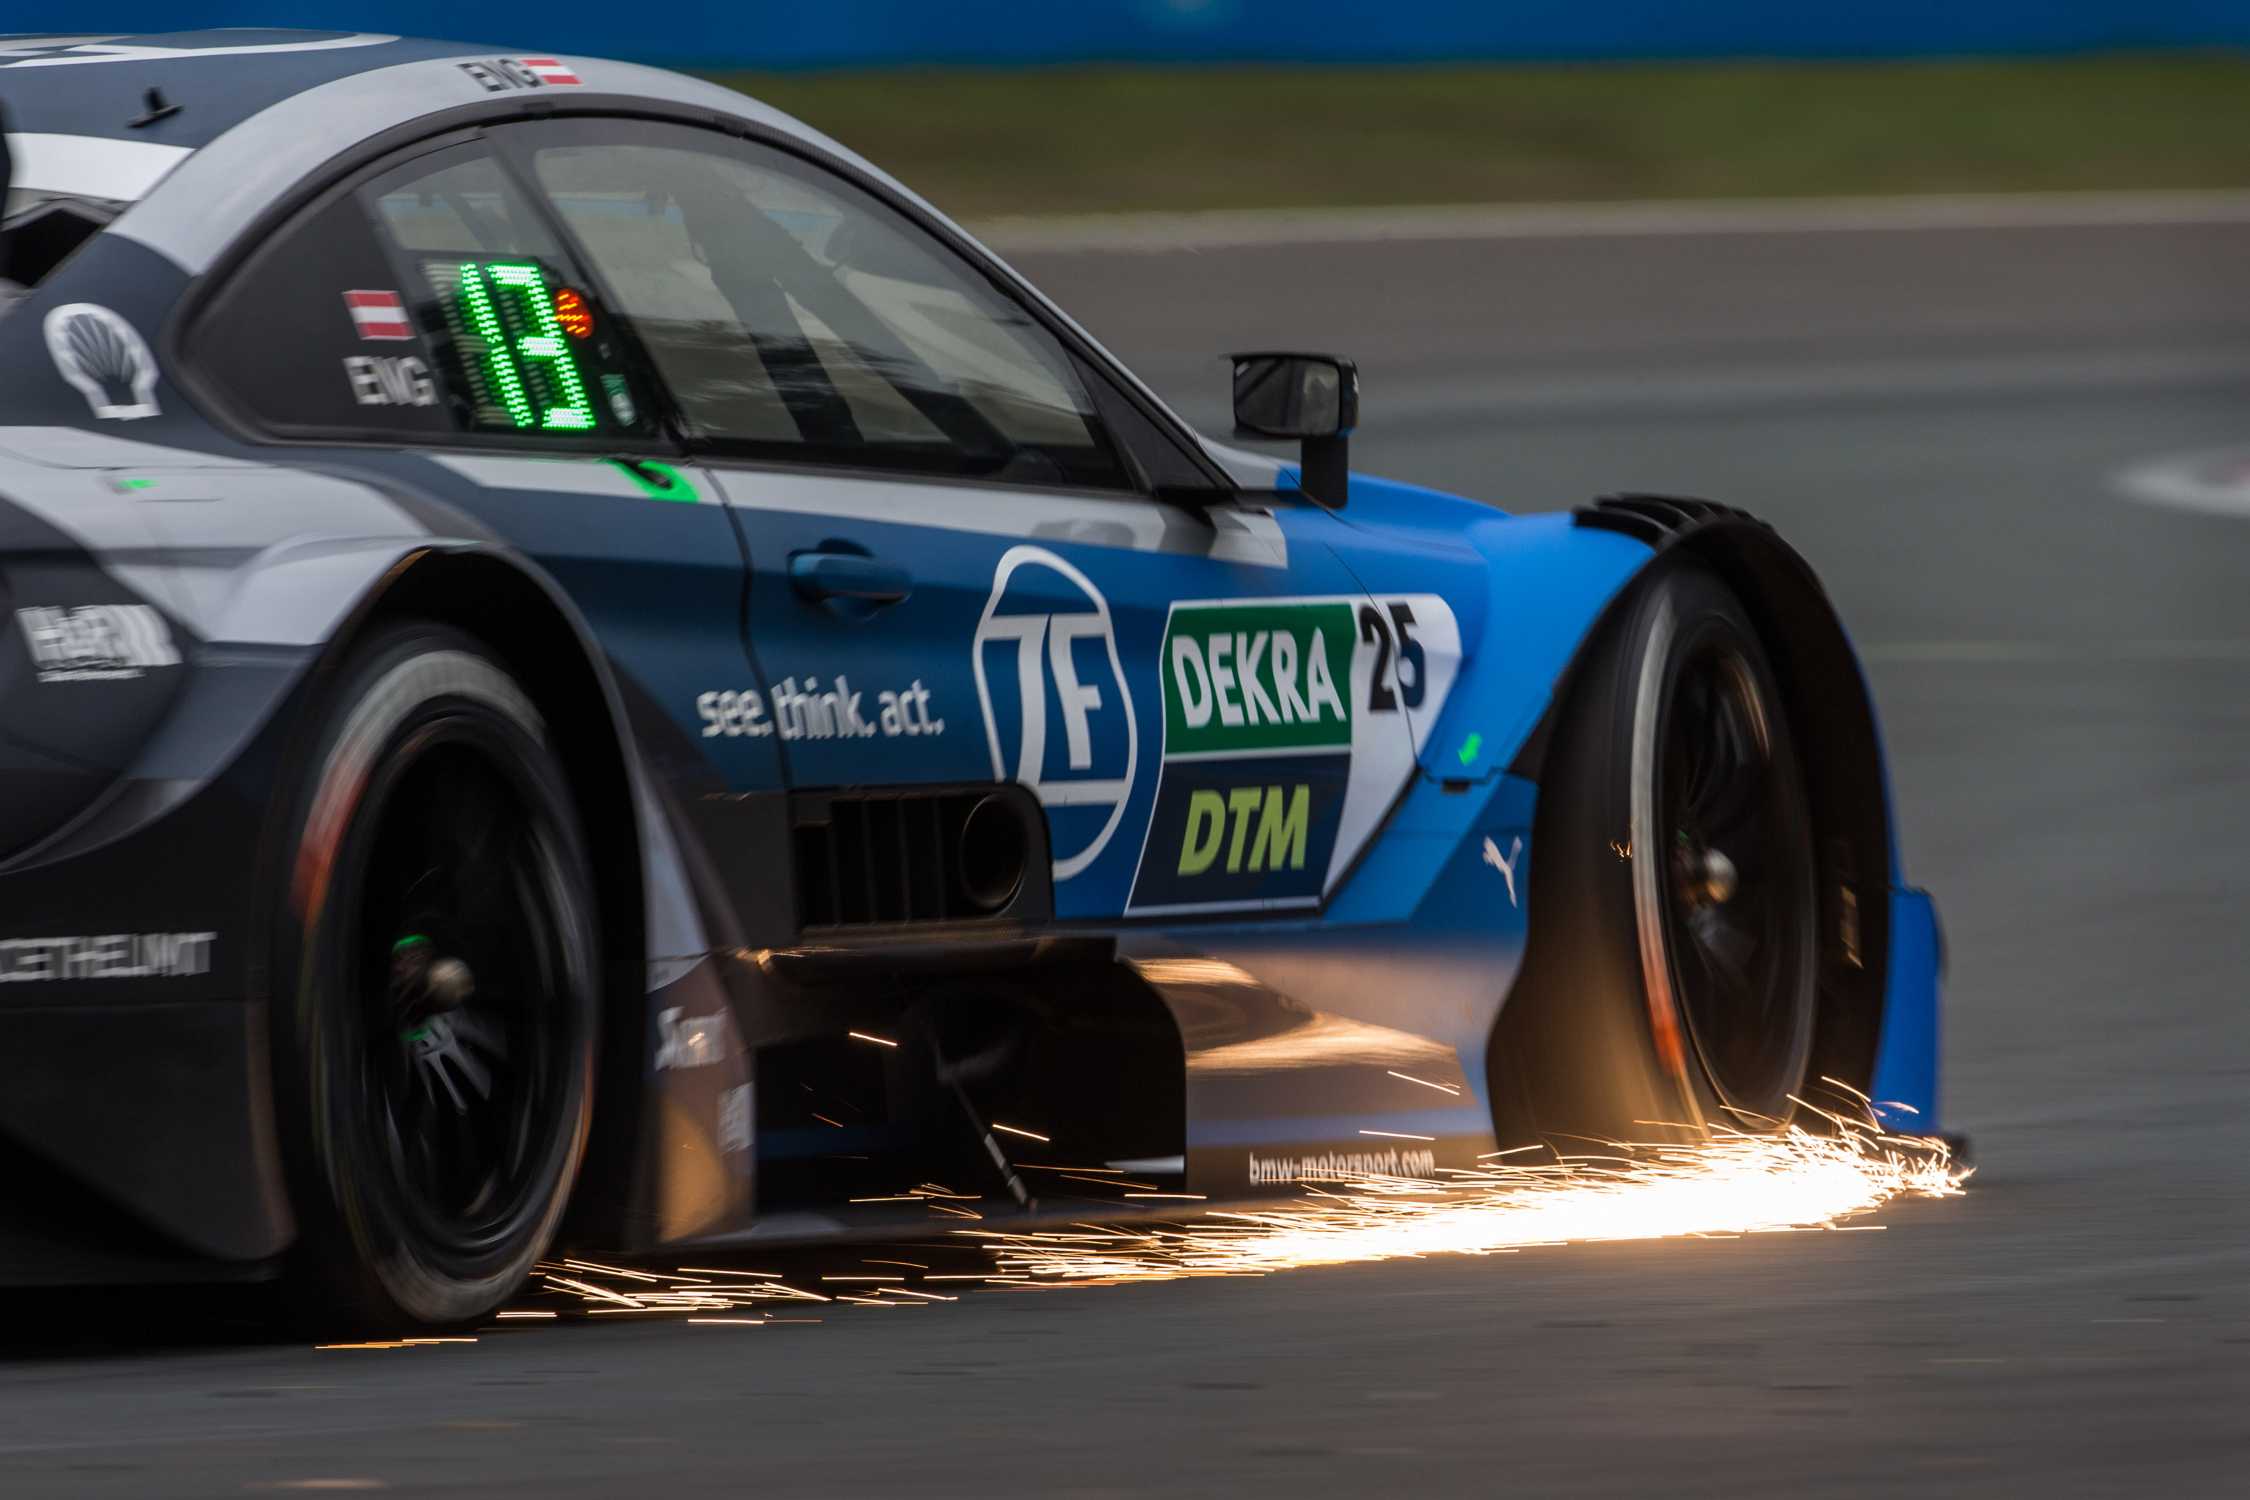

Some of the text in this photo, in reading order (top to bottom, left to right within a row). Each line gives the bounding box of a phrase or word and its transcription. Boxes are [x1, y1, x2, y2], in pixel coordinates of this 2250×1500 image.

[344, 355, 438, 406] ENG
[1172, 626, 1347, 729] DEKRA
[1358, 602, 1426, 714] 25
[696, 675, 946, 741] see. think. act.
[978, 612, 1130, 808] ZF
[1177, 784, 1310, 877] DTM
[1249, 1148, 1435, 1187] bmw-motorsport.com
